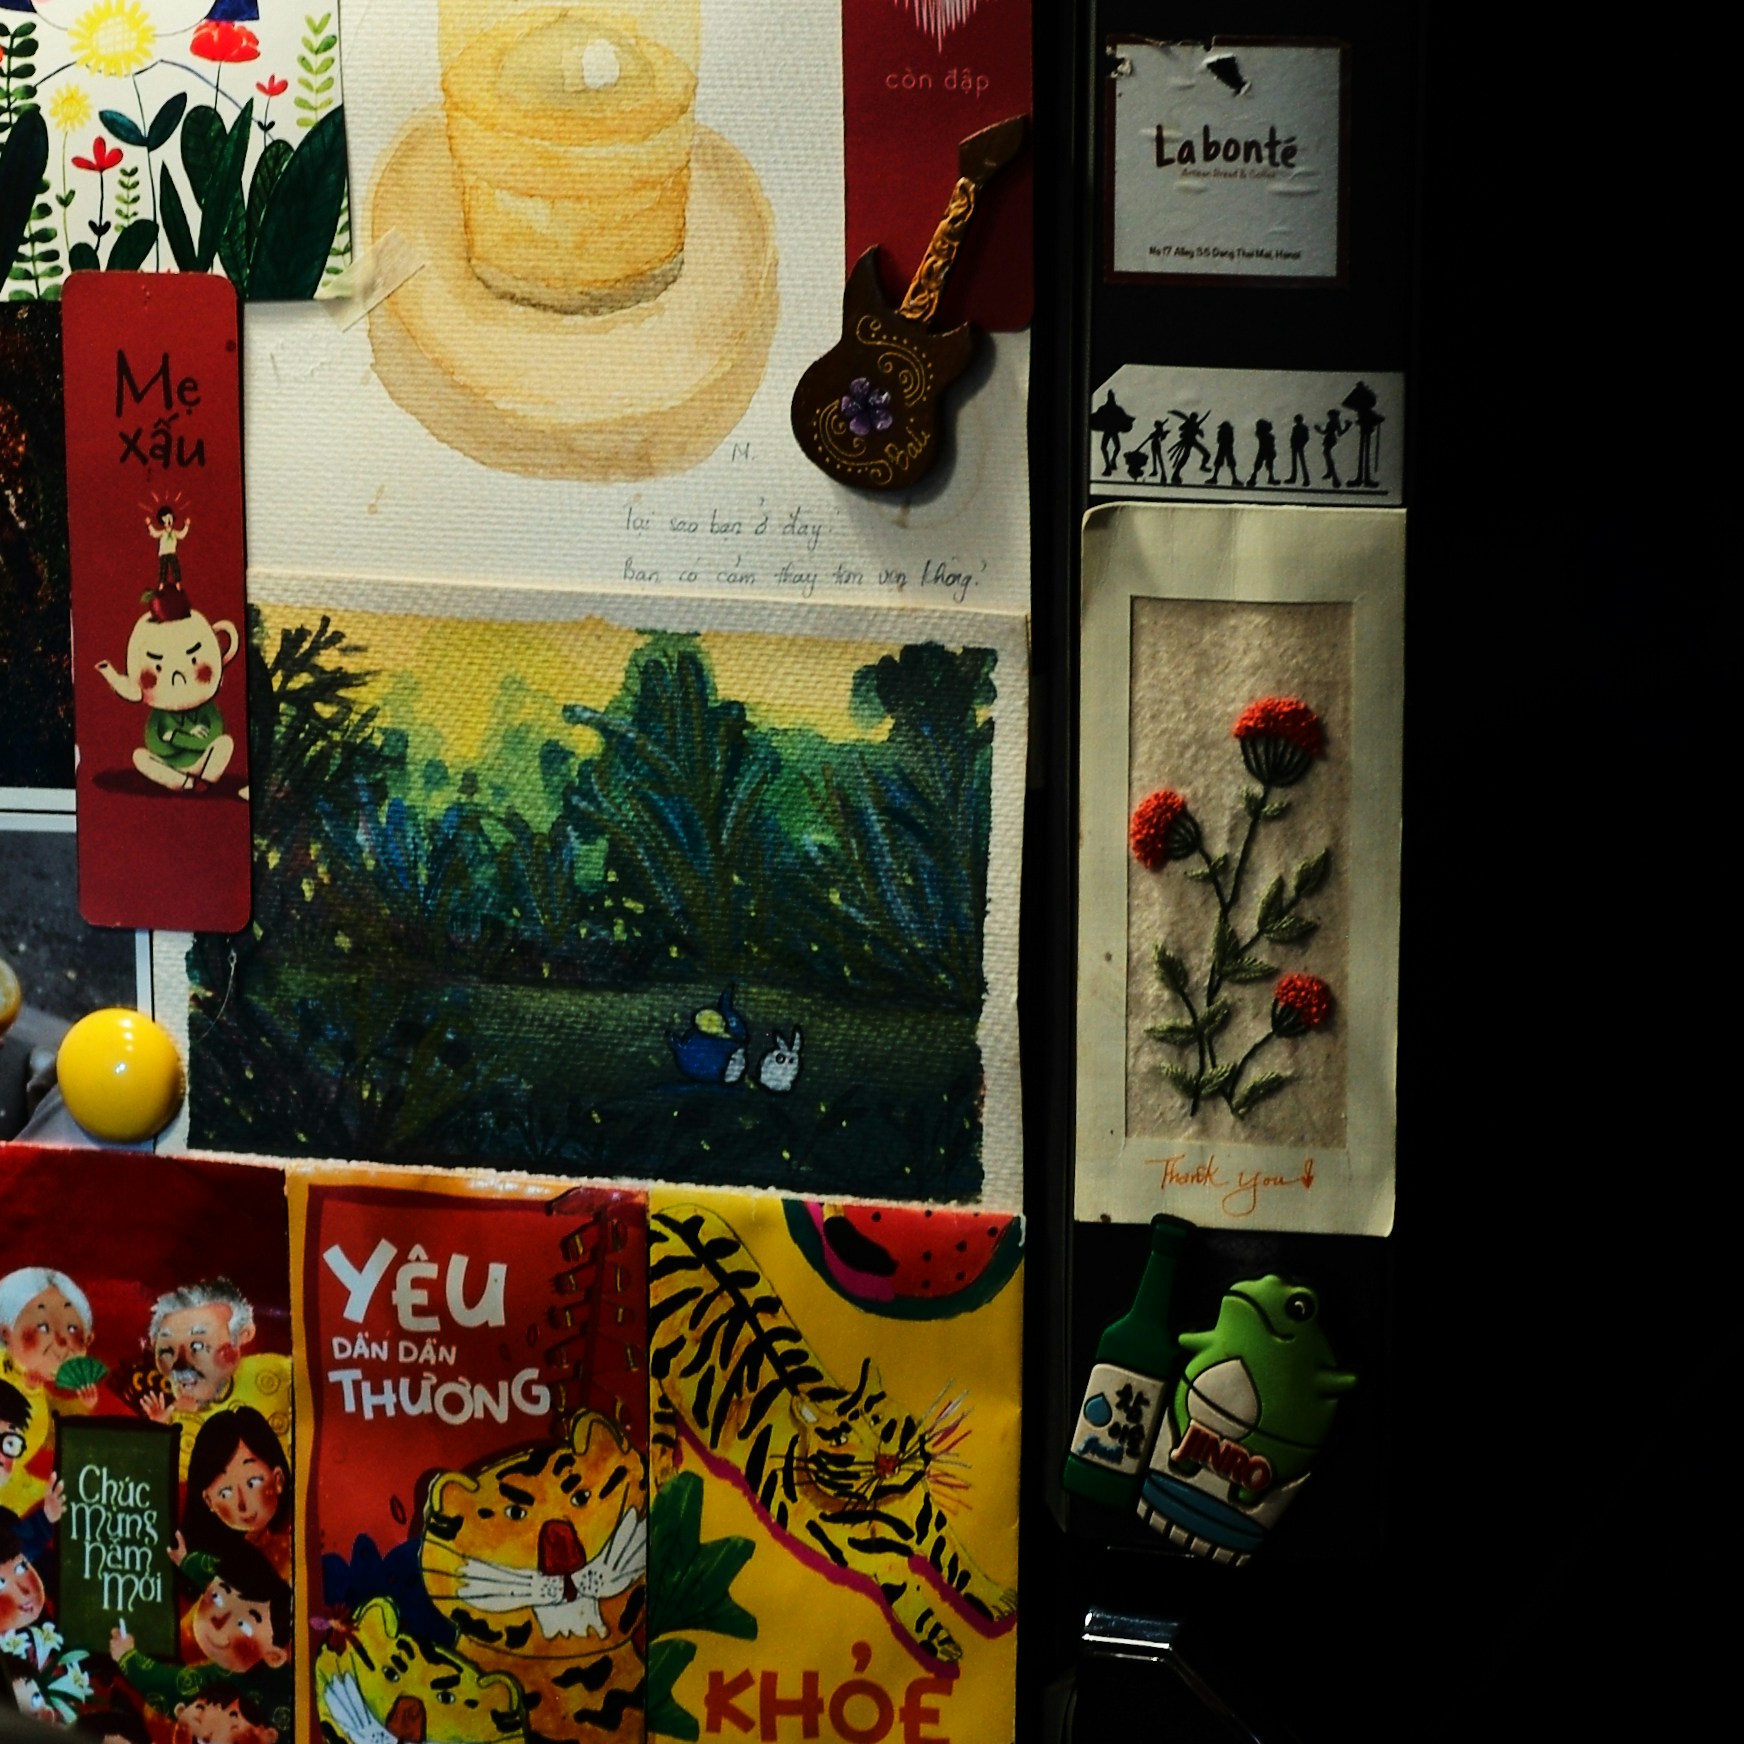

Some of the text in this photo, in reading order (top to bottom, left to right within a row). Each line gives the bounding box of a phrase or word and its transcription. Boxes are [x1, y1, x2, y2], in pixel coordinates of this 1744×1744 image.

[885, 67, 990, 98] còn đập
[114, 348, 202, 419] Mẹ
[118, 412, 206, 471] xấu
[1144, 1153, 1228, 1191] Thank
[322, 1237, 508, 1333] YÊU
[327, 1367, 552, 1426] THƯƠNG
[1170, 1419, 1273, 1493] JINRO
[78, 1463, 151, 1512] Chúc
